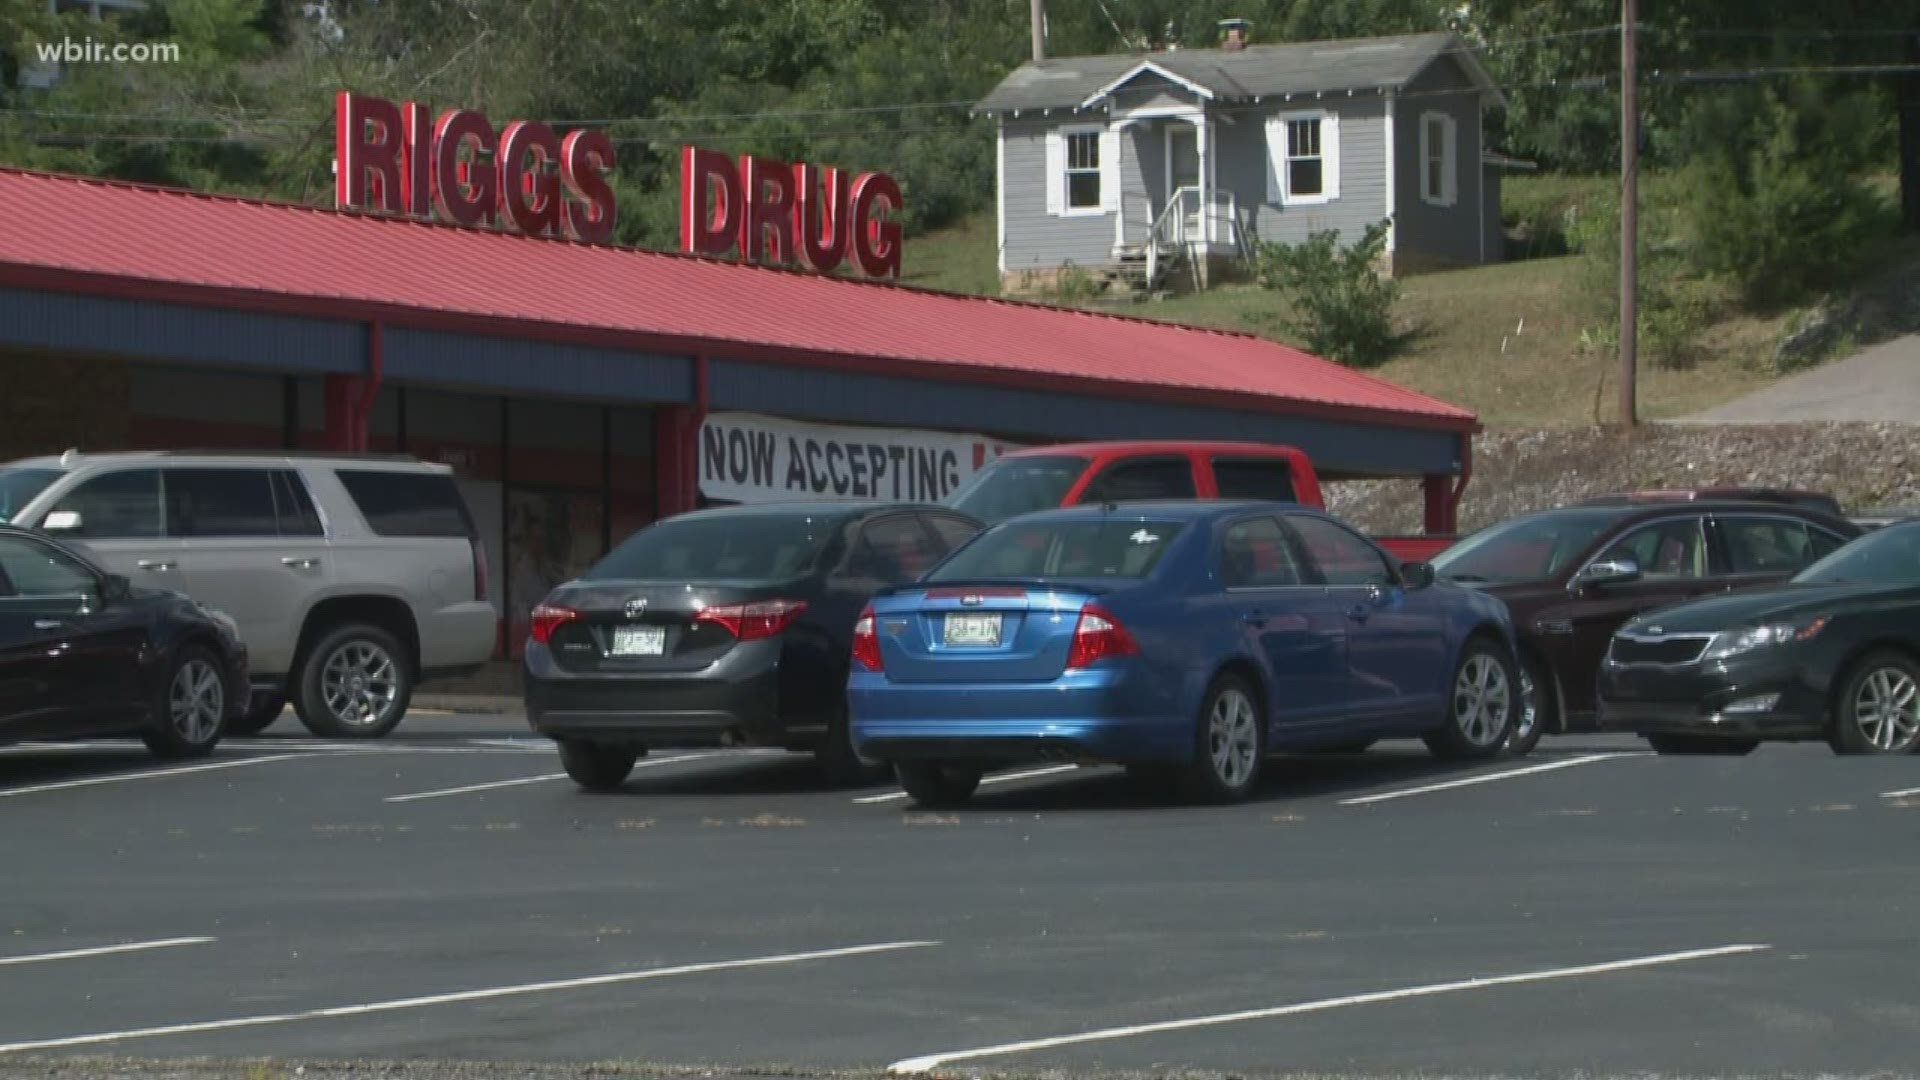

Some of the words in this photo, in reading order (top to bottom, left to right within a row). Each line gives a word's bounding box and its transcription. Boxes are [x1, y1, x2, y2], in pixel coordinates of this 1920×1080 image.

[336, 91, 616, 243] RIGGS
[681, 145, 903, 280] DRUG
[703, 424, 775, 488] NOW
[786, 437, 960, 502] ACCEPTING
